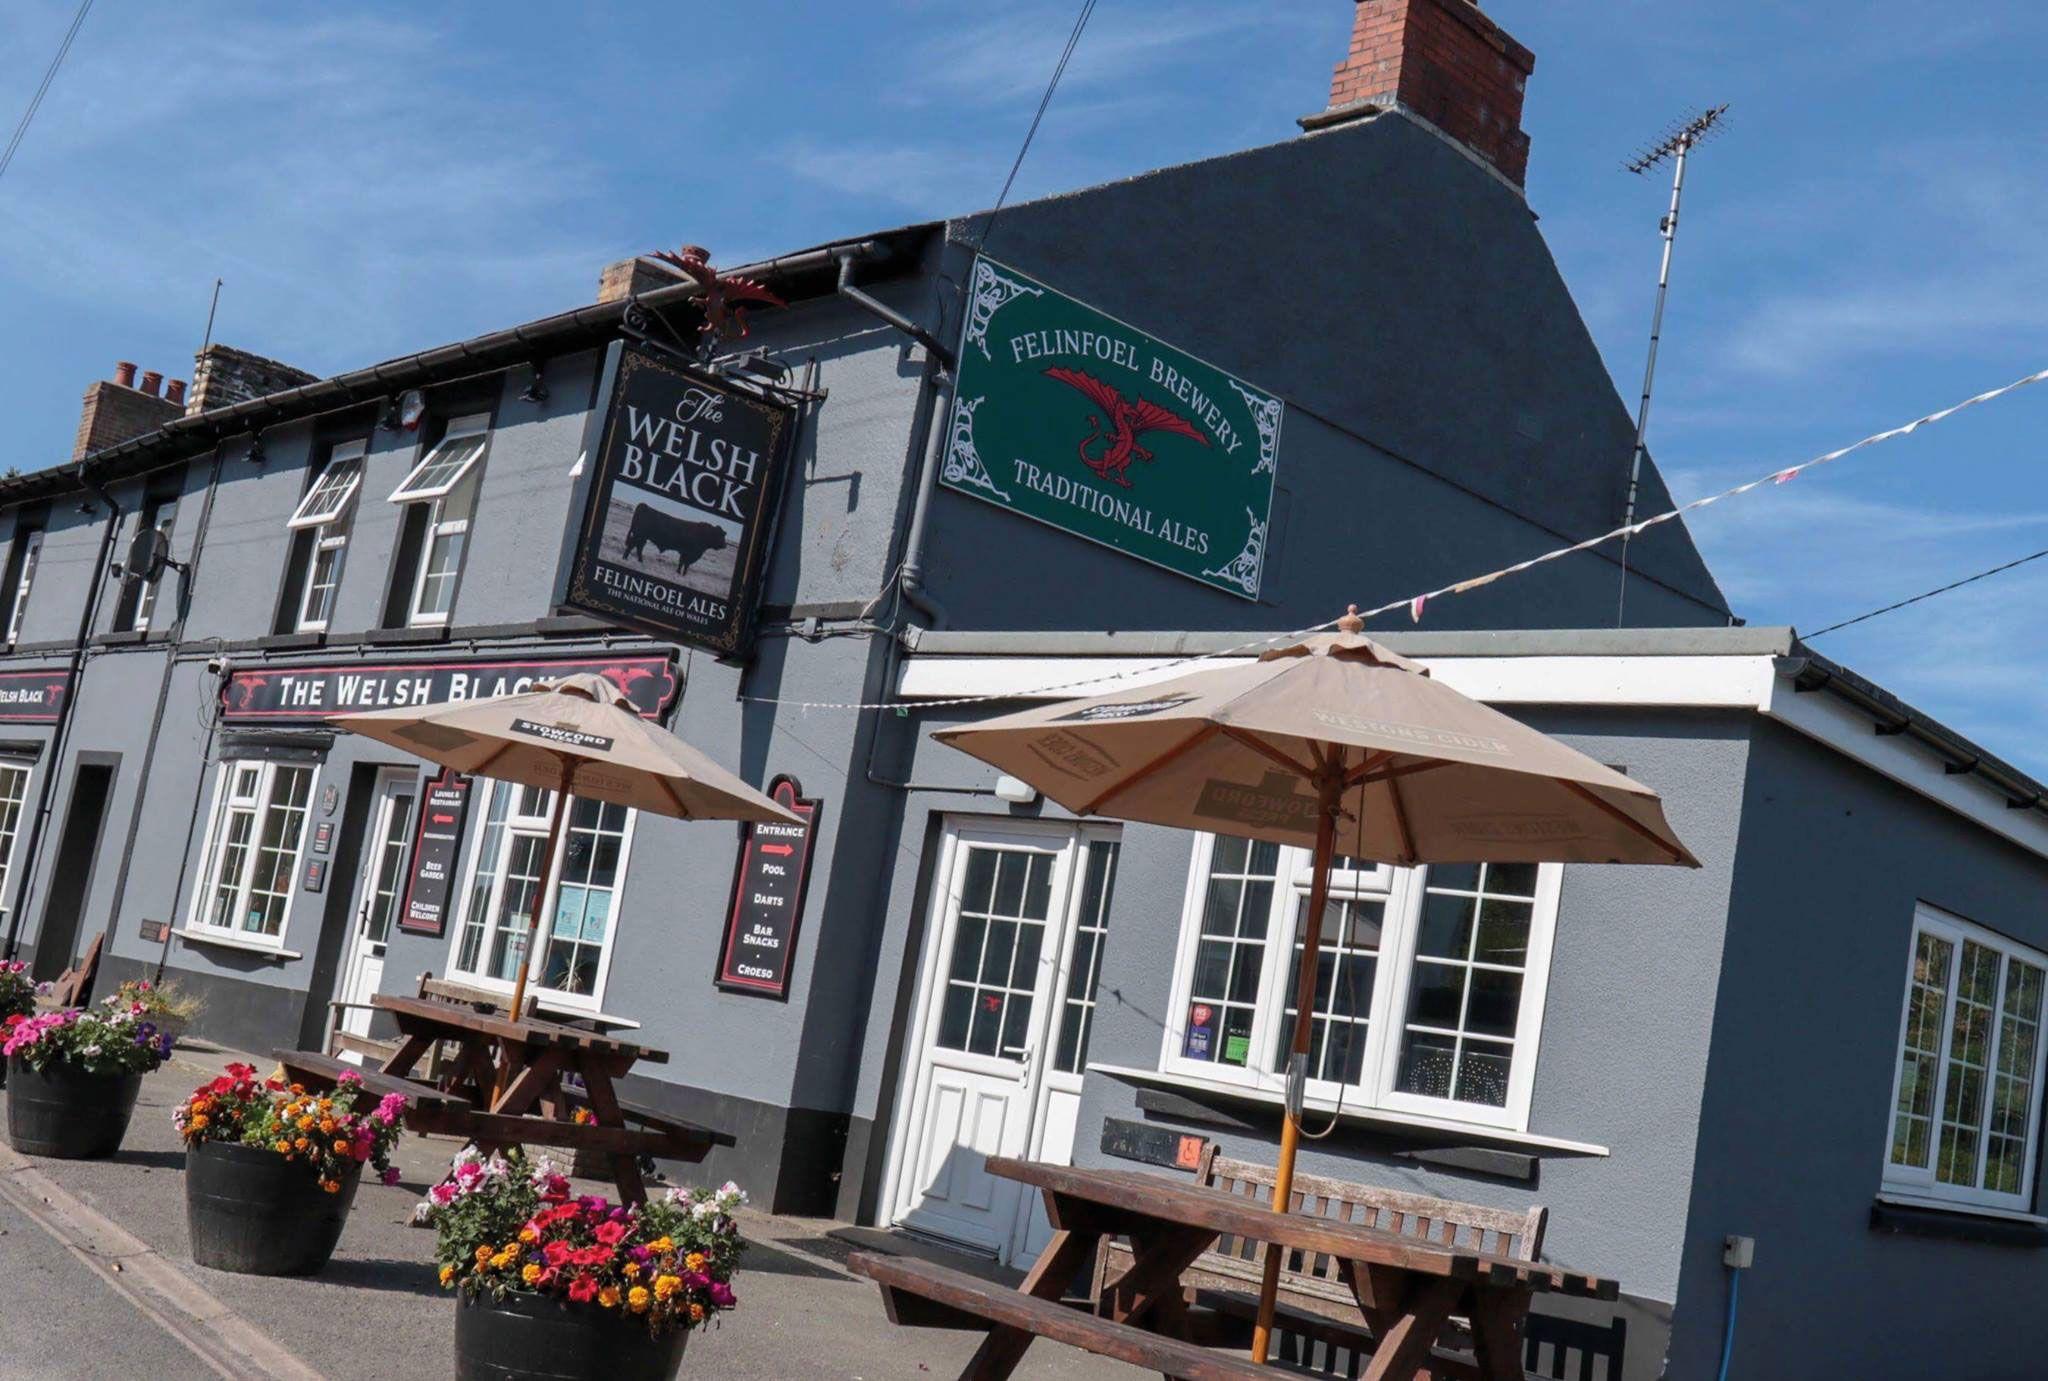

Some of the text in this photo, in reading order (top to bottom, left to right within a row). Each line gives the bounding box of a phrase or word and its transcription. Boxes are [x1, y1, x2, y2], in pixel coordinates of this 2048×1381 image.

[1010, 330, 1243, 455] FELINFOEL BREWERY
[676, 388, 723, 424] The
[627, 405, 760, 485] WELSH
[619, 443, 748, 518] BLACK
[1013, 458, 1209, 555] TRADITIONAL ALES
[593, 565, 727, 620] FELINFOEL ALES
[607, 587, 621, 599] THE
[623, 593, 660, 610] NATIONAL
[280, 673, 556, 706] THE WELSH BLAC
[520, 721, 606, 745] STOWFORD
[757, 823, 805, 837] ENTRANCE
[425, 861, 442, 871] BEER
[762, 863, 786, 876] POOL
[420, 869, 444, 880] GARDEN
[411, 900, 440, 912] CHILDREN
[754, 893, 784, 906] DARTS
[410, 908, 438, 921] WELCOME
[753, 924, 773, 936] BAR
[743, 933, 779, 949] SNACKS
[737, 964, 773, 979] CROESO
